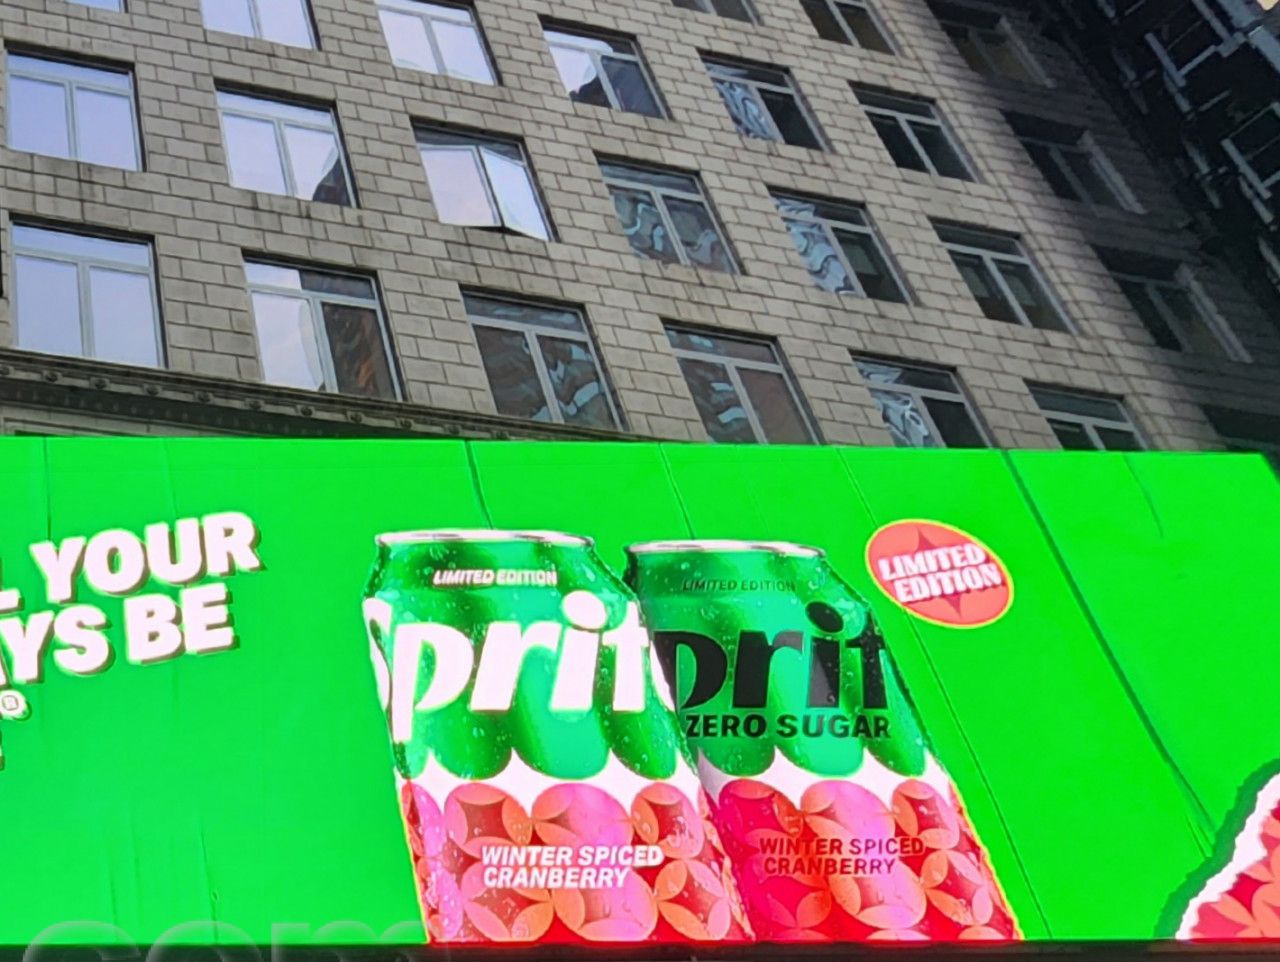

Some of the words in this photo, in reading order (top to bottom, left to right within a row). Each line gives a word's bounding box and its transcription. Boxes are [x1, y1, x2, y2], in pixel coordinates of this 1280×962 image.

[30, 512, 263, 604] YOUR
[878, 543, 986, 581] LIMITED
[432, 569, 494, 587] LIMITED
[496, 569, 558, 587] EDITION
[682, 579, 737, 593] LIMITED
[893, 563, 1002, 603] EDITION
[124, 582, 237, 664] BE
[363, 590, 676, 742] prit
[685, 713, 767, 738] ZERO
[776, 713, 890, 738] SUGAR
[481, 845, 573, 867] WINTER
[577, 845, 664, 867] SPICED
[759, 837, 843, 857] WINTER
[850, 837, 924, 856] SPICED
[483, 866, 632, 889] CRANBERRY
[764, 857, 896, 876] CRANBERRY
